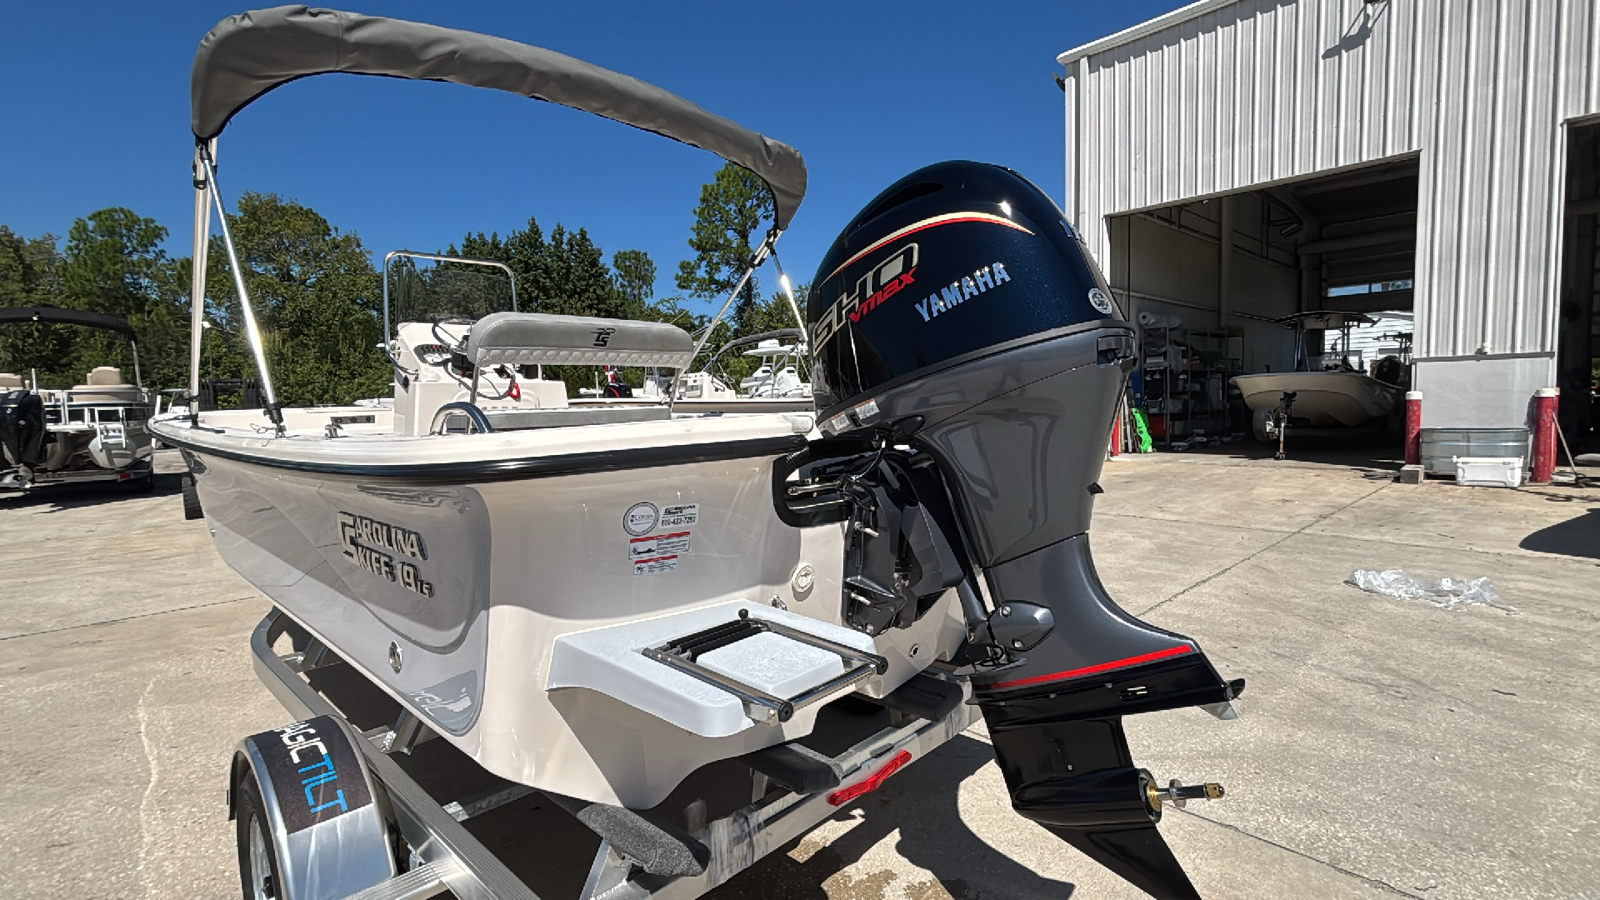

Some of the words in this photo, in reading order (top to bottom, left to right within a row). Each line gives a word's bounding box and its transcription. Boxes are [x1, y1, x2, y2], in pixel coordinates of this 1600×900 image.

[813, 242, 919, 357] SHO
[914, 261, 1012, 323] YAMAHA
[337, 510, 428, 561] CAROLINA
